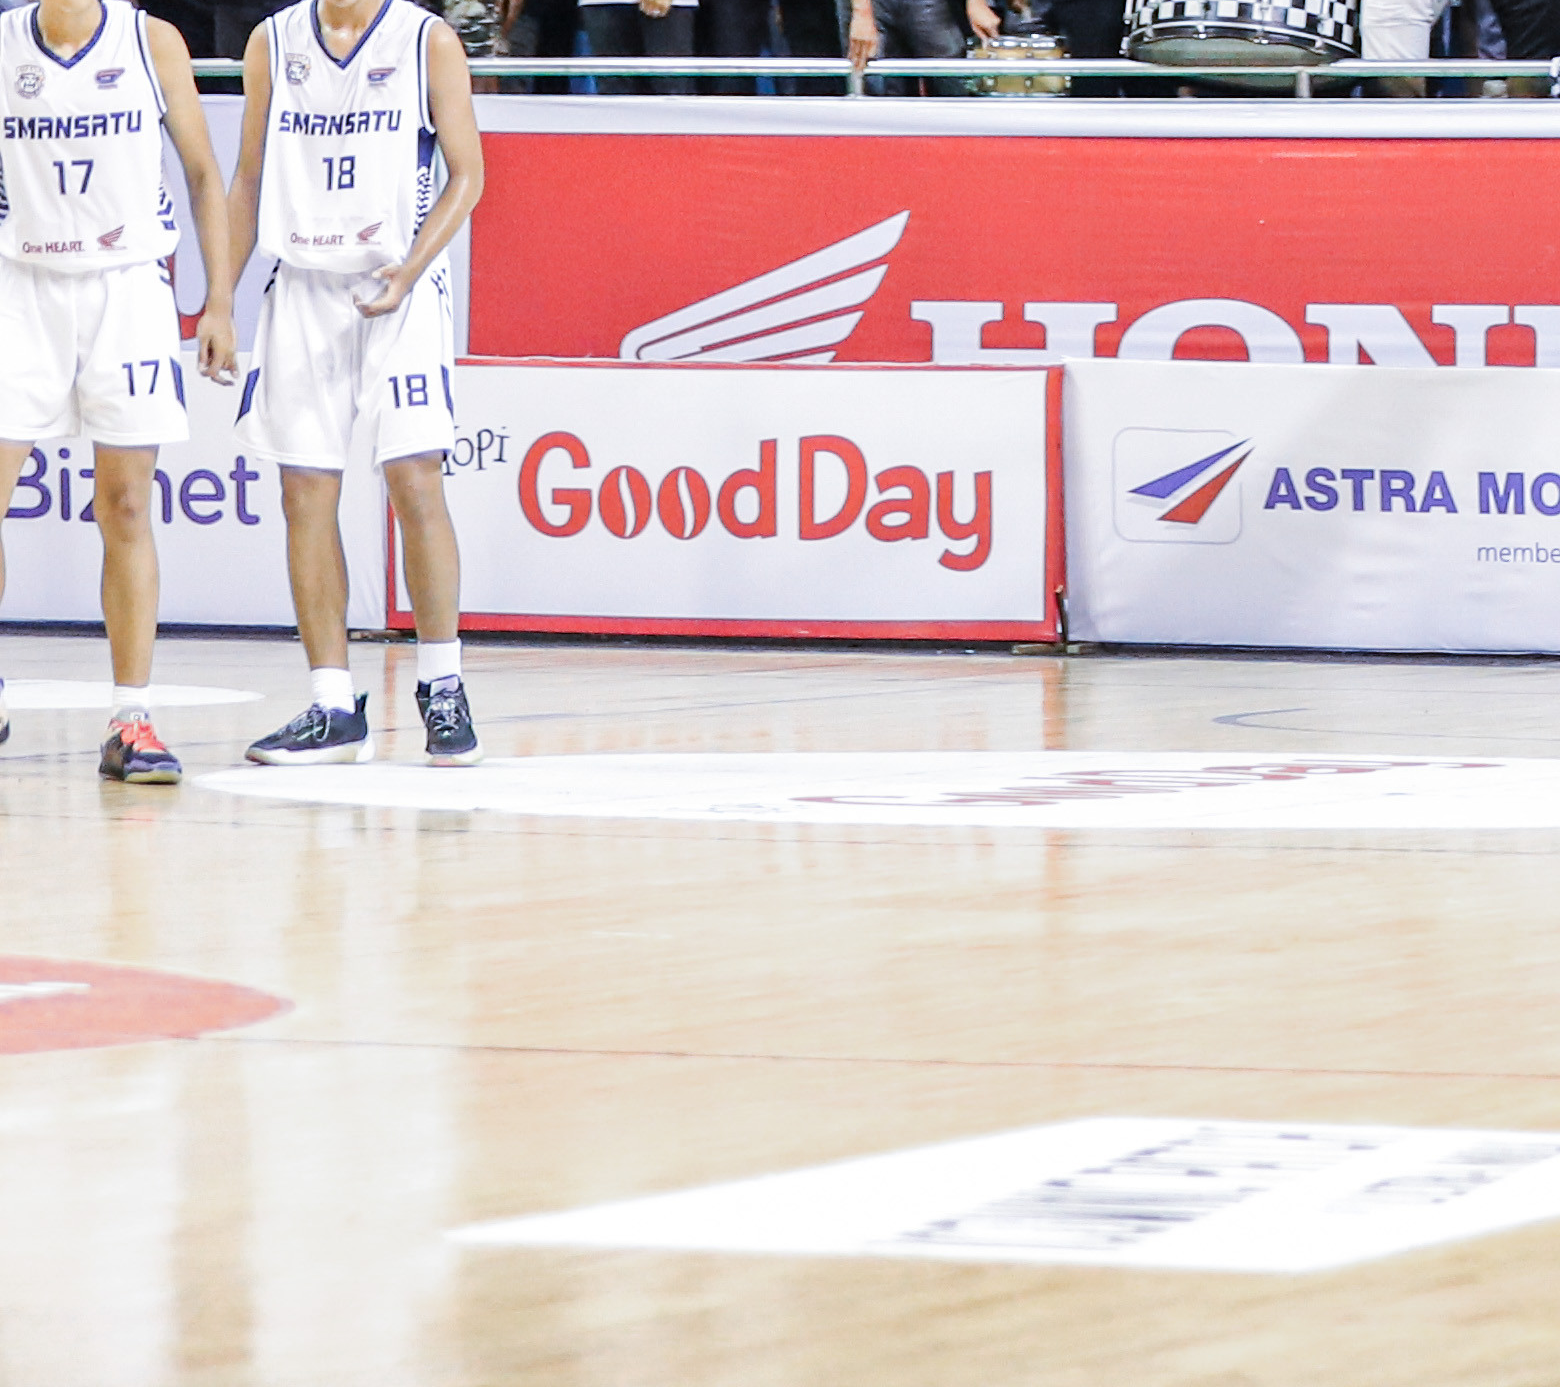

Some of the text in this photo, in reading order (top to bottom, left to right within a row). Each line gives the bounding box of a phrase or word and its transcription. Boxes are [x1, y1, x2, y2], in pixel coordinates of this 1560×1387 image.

[4, 110, 141, 140] SMANSATU
[279, 110, 401, 136] SMANSATU
[53, 159, 94, 195] 17
[322, 155, 355, 191] 18
[122, 360, 160, 397] 17
[388, 374, 428, 408] 18
[518, 431, 777, 540] Good
[799, 433, 992, 572] Day
[1264, 467, 1457, 514] ASTRA
